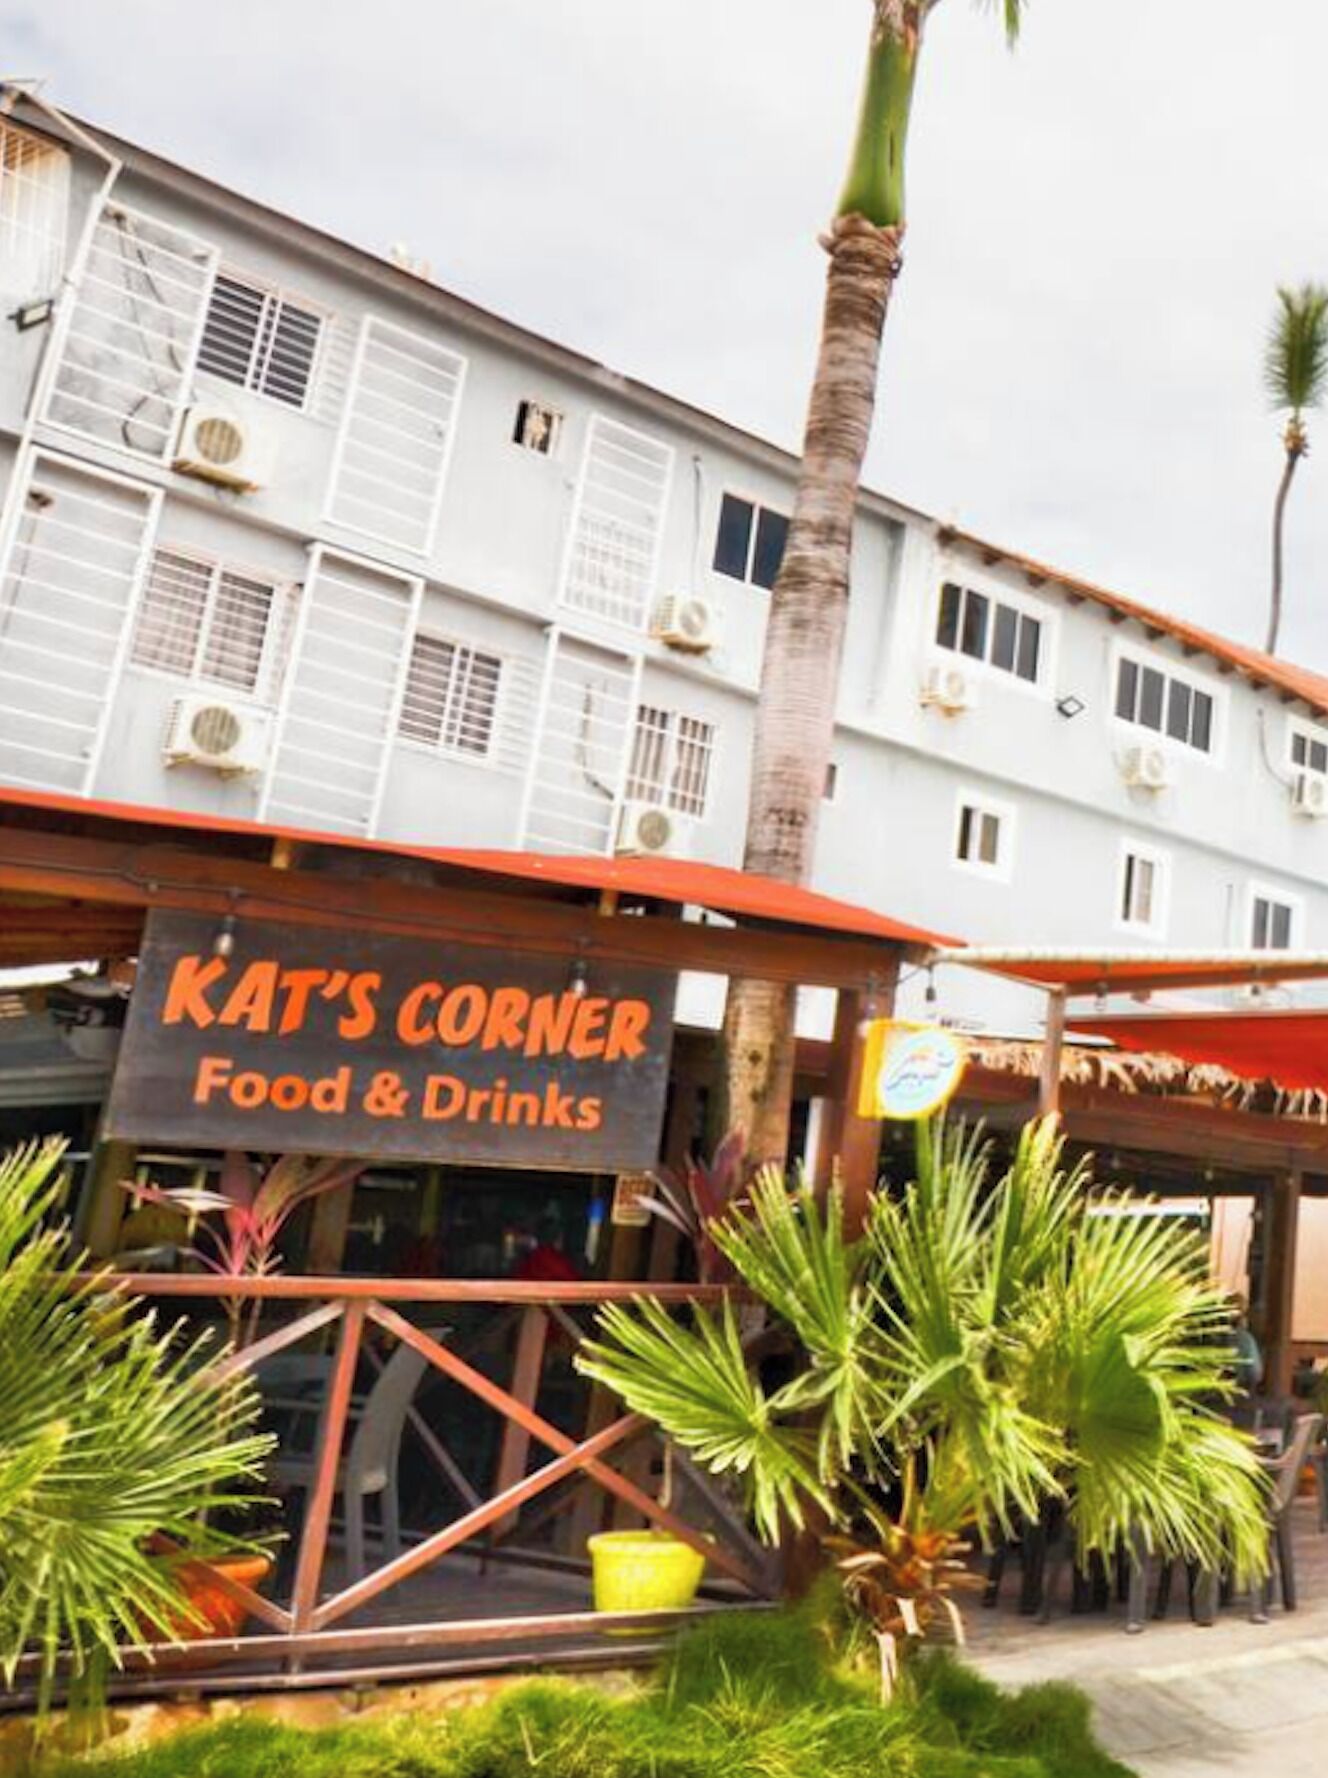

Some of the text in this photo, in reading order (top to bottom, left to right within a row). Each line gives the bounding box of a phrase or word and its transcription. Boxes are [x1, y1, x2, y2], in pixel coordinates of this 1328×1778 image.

[163, 955, 651, 1062] KAT'S CORNER
[194, 1057, 601, 1130] Food & Drinks
